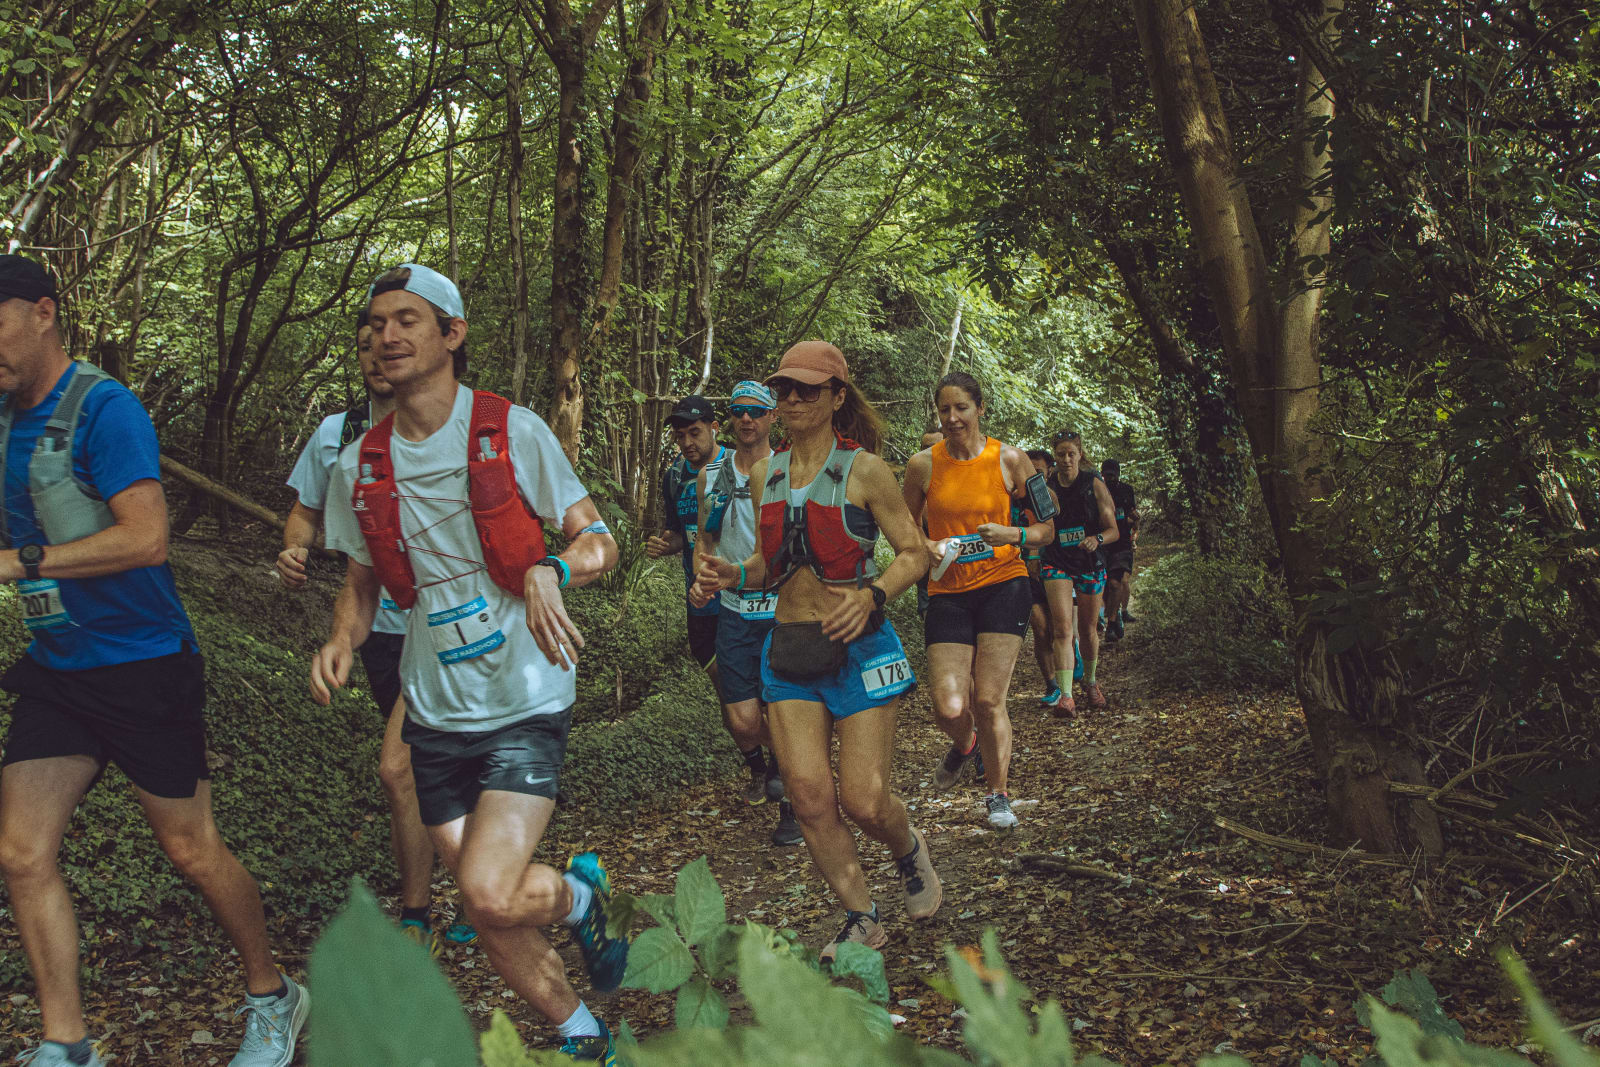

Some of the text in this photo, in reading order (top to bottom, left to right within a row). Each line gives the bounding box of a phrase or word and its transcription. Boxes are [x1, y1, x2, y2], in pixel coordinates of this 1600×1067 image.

[959, 541, 986, 556] 236
[22, 593, 50, 616] 207
[747, 599, 771, 612] 377
[459, 637, 498, 657] MARATHON
[877, 662, 904, 687] 178
